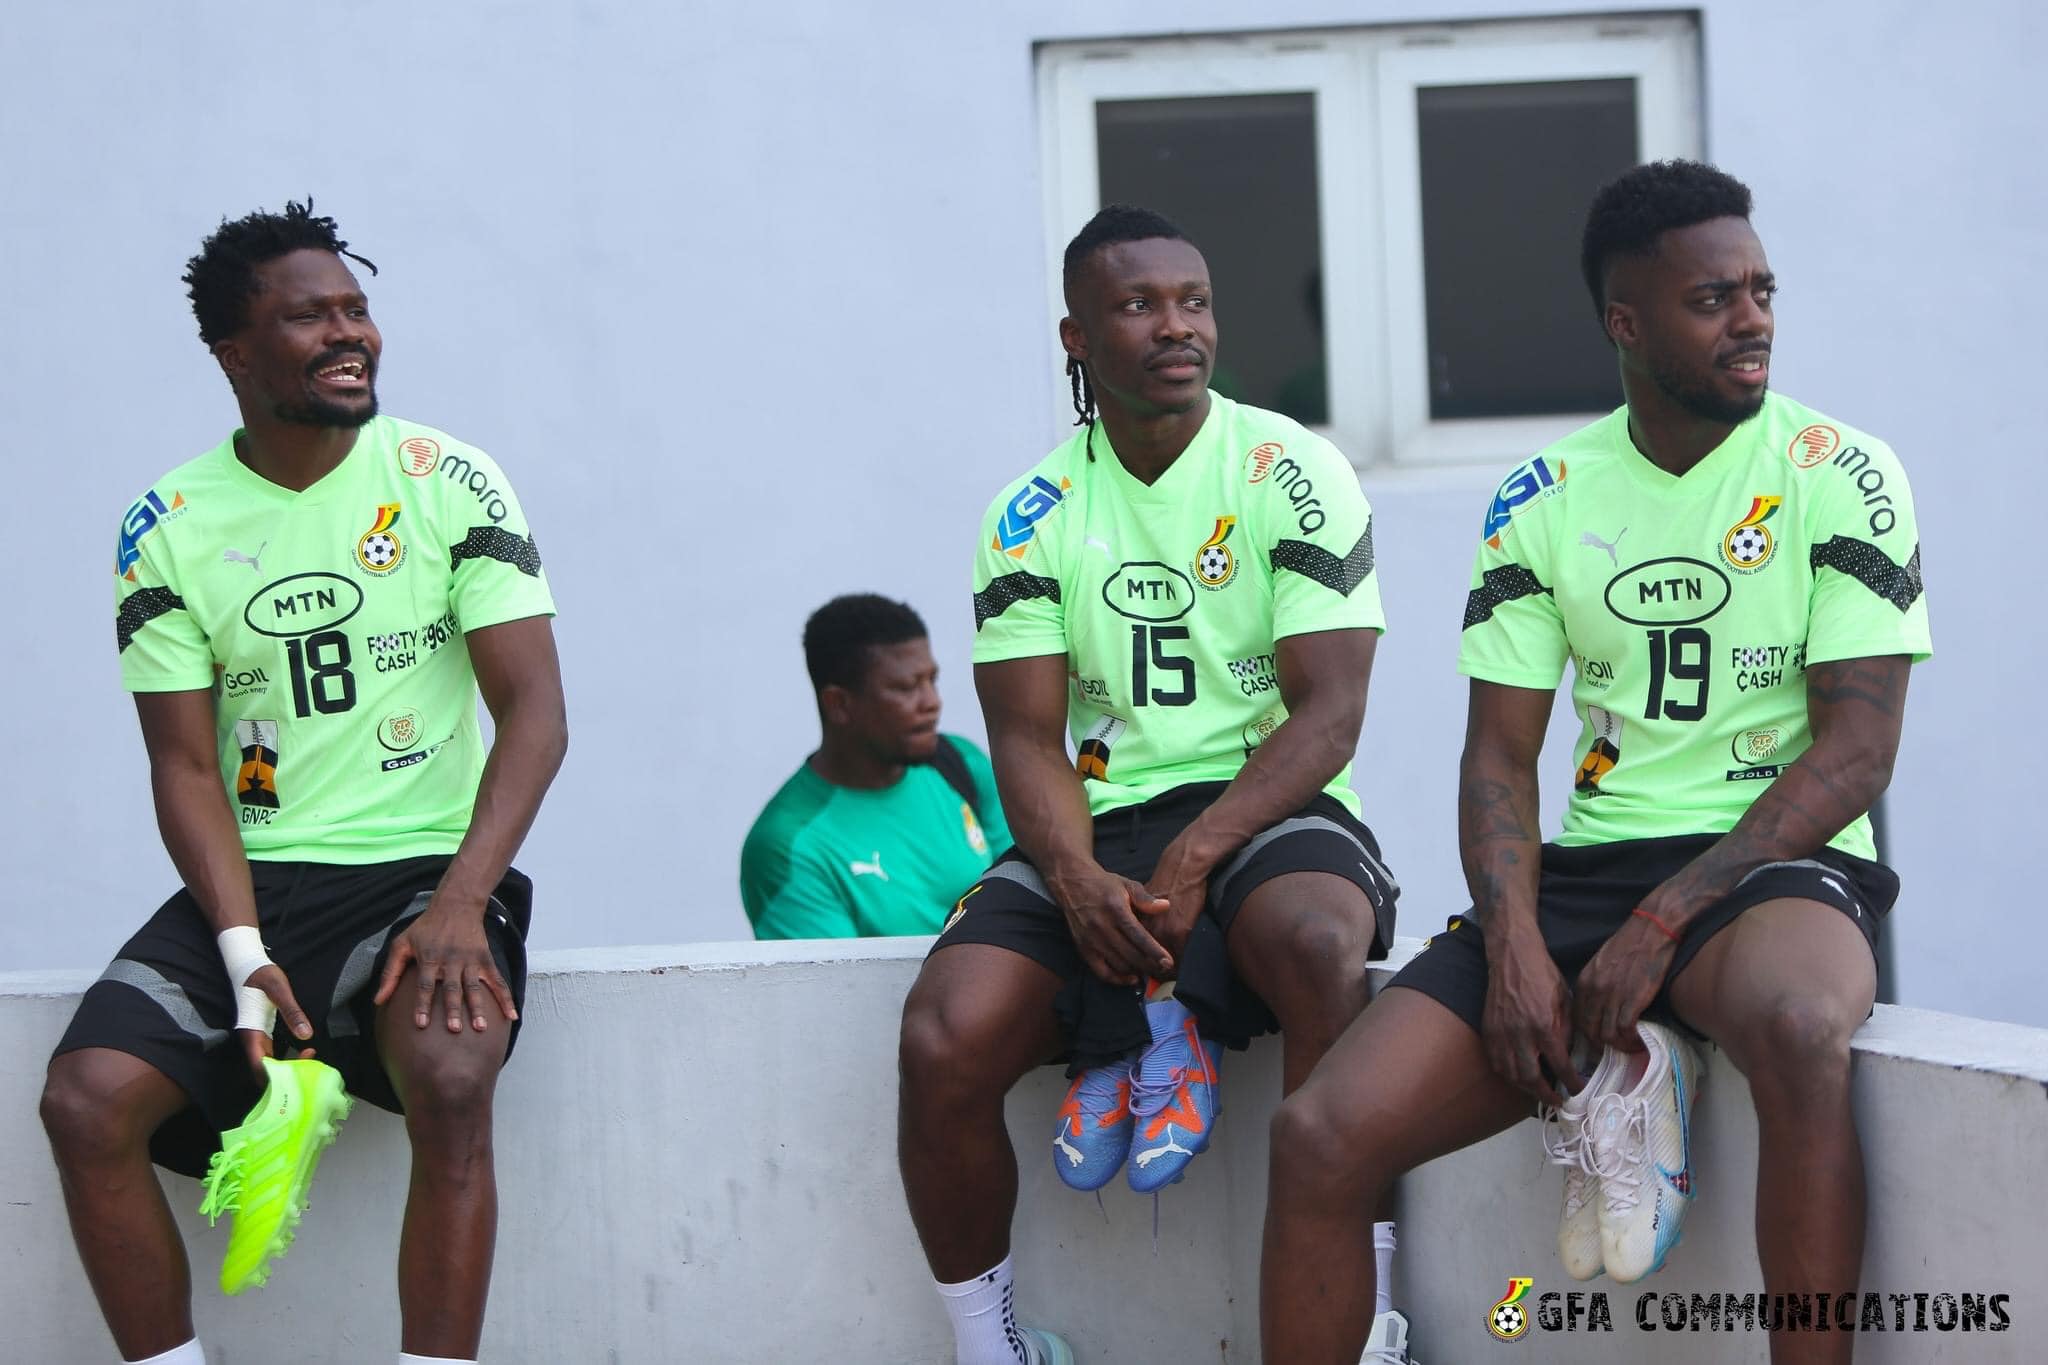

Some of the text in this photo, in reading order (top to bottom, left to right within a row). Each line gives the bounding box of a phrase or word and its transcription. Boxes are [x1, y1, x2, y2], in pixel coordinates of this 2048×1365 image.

[440, 456, 507, 523] mara
[997, 475, 1063, 551] LGI
[1273, 458, 1325, 535] mara
[1833, 446, 1896, 538] mara
[273, 587, 337, 618] MTN
[1127, 578, 1178, 602] MTN
[1639, 576, 1703, 604] MTN
[225, 667, 270, 689] GOIL
[285, 630, 357, 719] 18
[1132, 624, 1197, 707] 15
[1644, 627, 1712, 722] 19
[1732, 770, 1774, 780] GOLD
